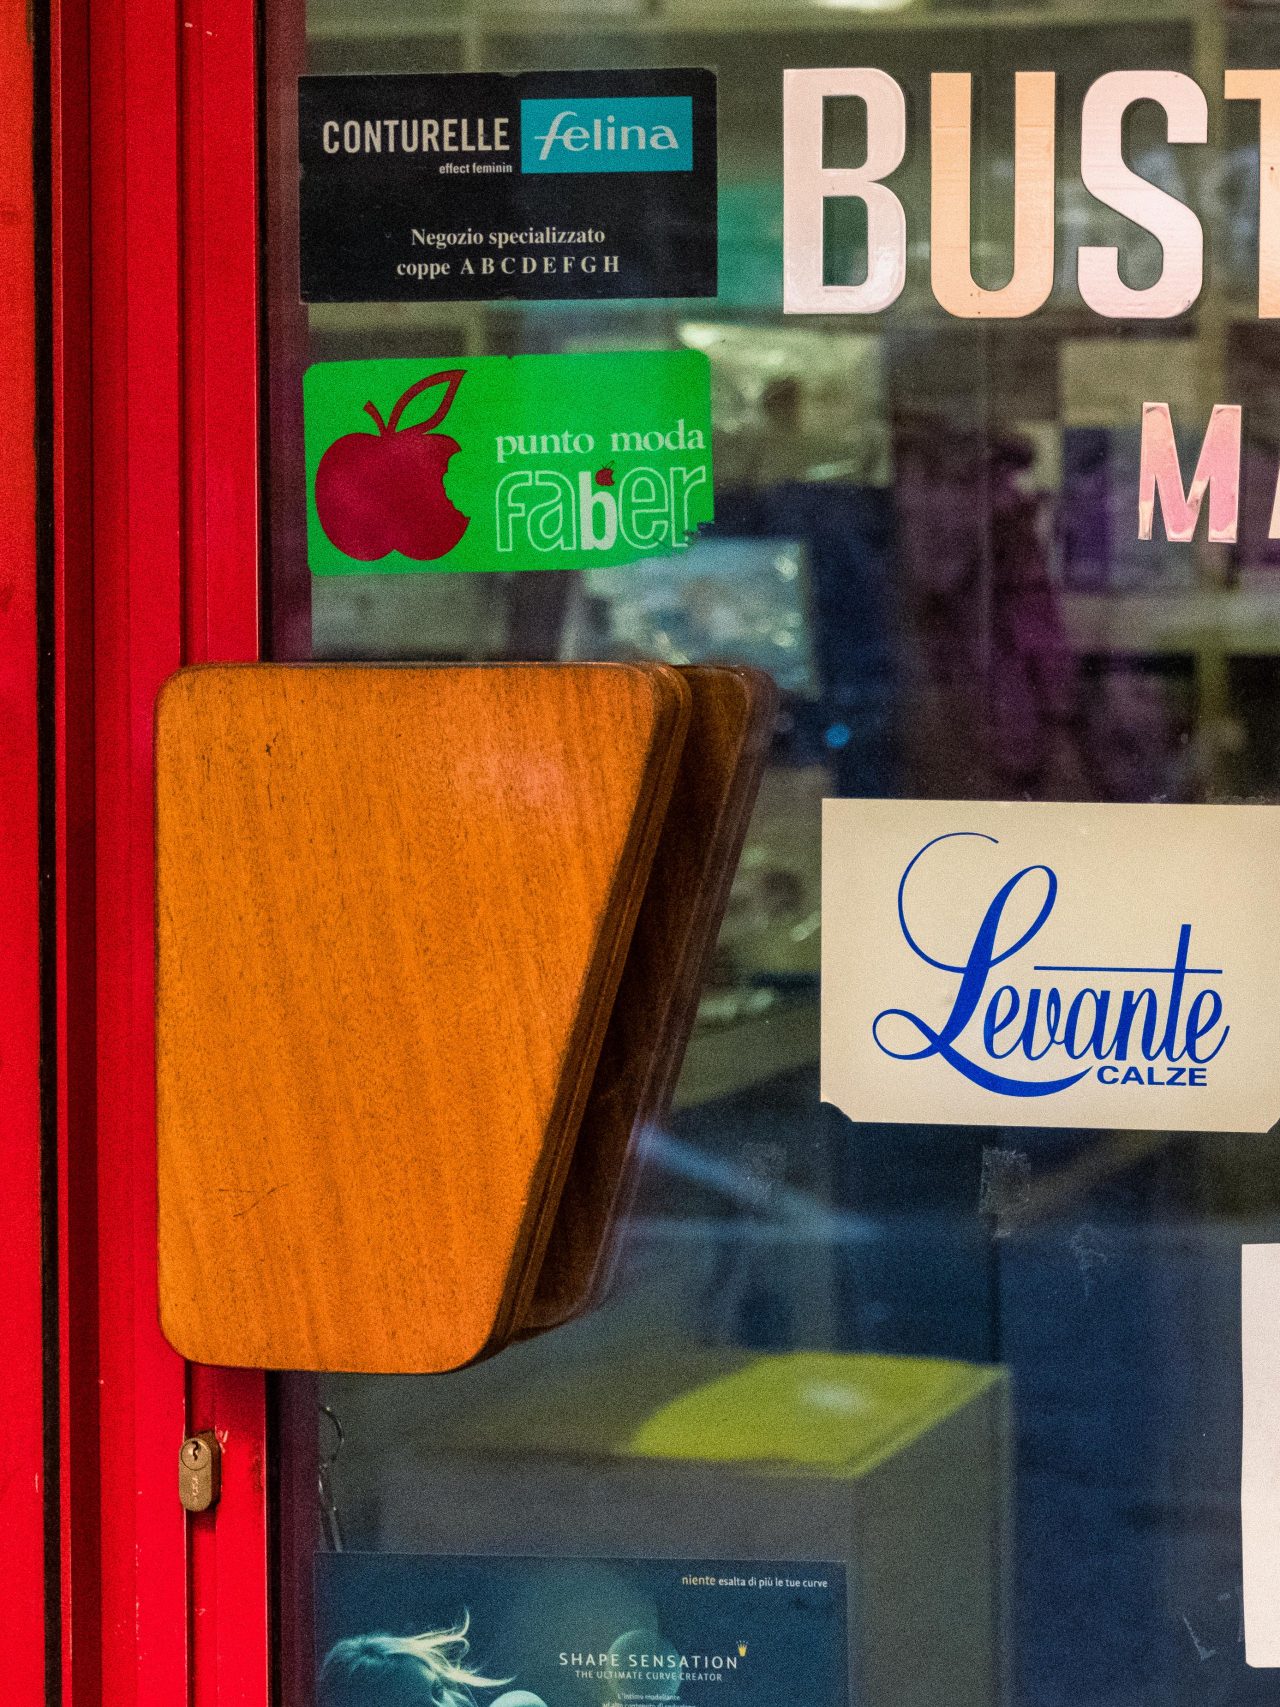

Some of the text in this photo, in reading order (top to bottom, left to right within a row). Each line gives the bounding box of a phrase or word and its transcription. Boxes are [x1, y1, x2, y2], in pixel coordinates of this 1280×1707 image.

[322, 117, 510, 154] CONTURELLE
[534, 110, 680, 161] felina
[439, 161, 513, 174] effect feminin
[411, 226, 605, 249] Negozio specializzato
[397, 255, 620, 280] coppe A B C D E F G H
[495, 419, 706, 463] punto moda
[495, 465, 706, 552] faber
[872, 832, 1230, 1097] Levante
[1096, 1065, 1208, 1087] CALZE
[682, 1574, 828, 1589] niente esalta di più le tue curve
[559, 1652, 738, 1669] SHAPE SENSATION
[575, 1670, 722, 1682] THE ULTIMATE CURVE CREATOR
